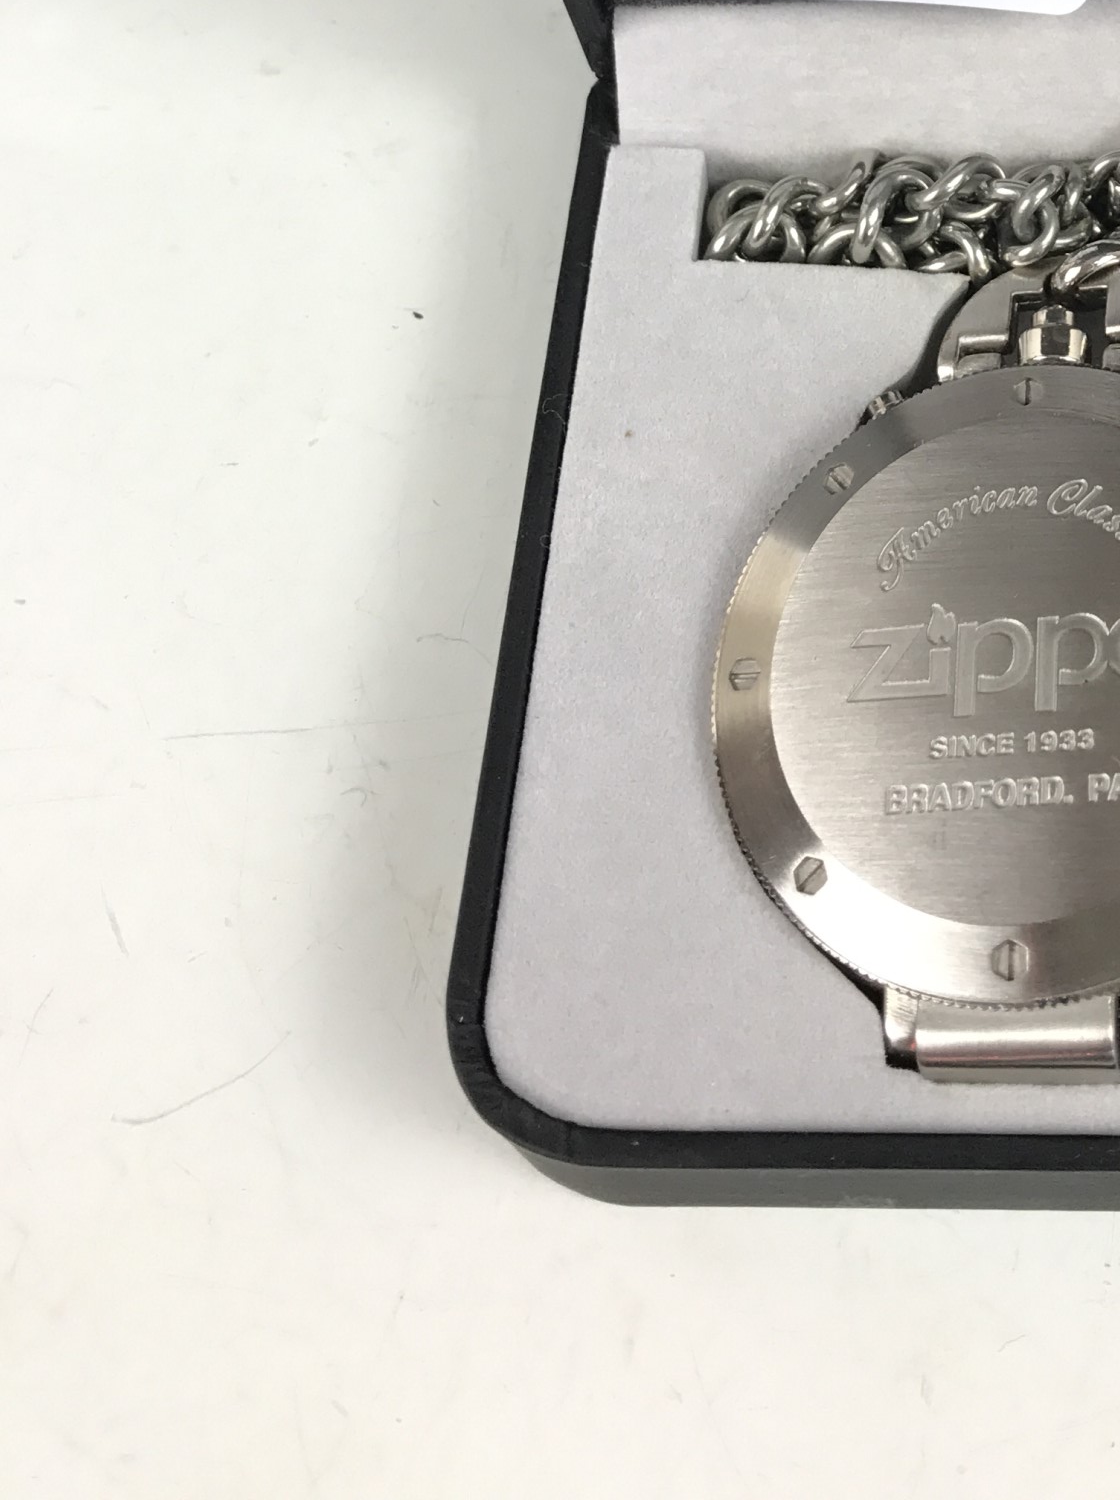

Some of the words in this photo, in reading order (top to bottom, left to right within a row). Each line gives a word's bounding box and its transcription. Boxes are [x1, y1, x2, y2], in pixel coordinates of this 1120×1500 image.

[876, 484, 1039, 592] American
[929, 731, 1015, 760] SINCE
[1023, 728, 1096, 753] 1933
